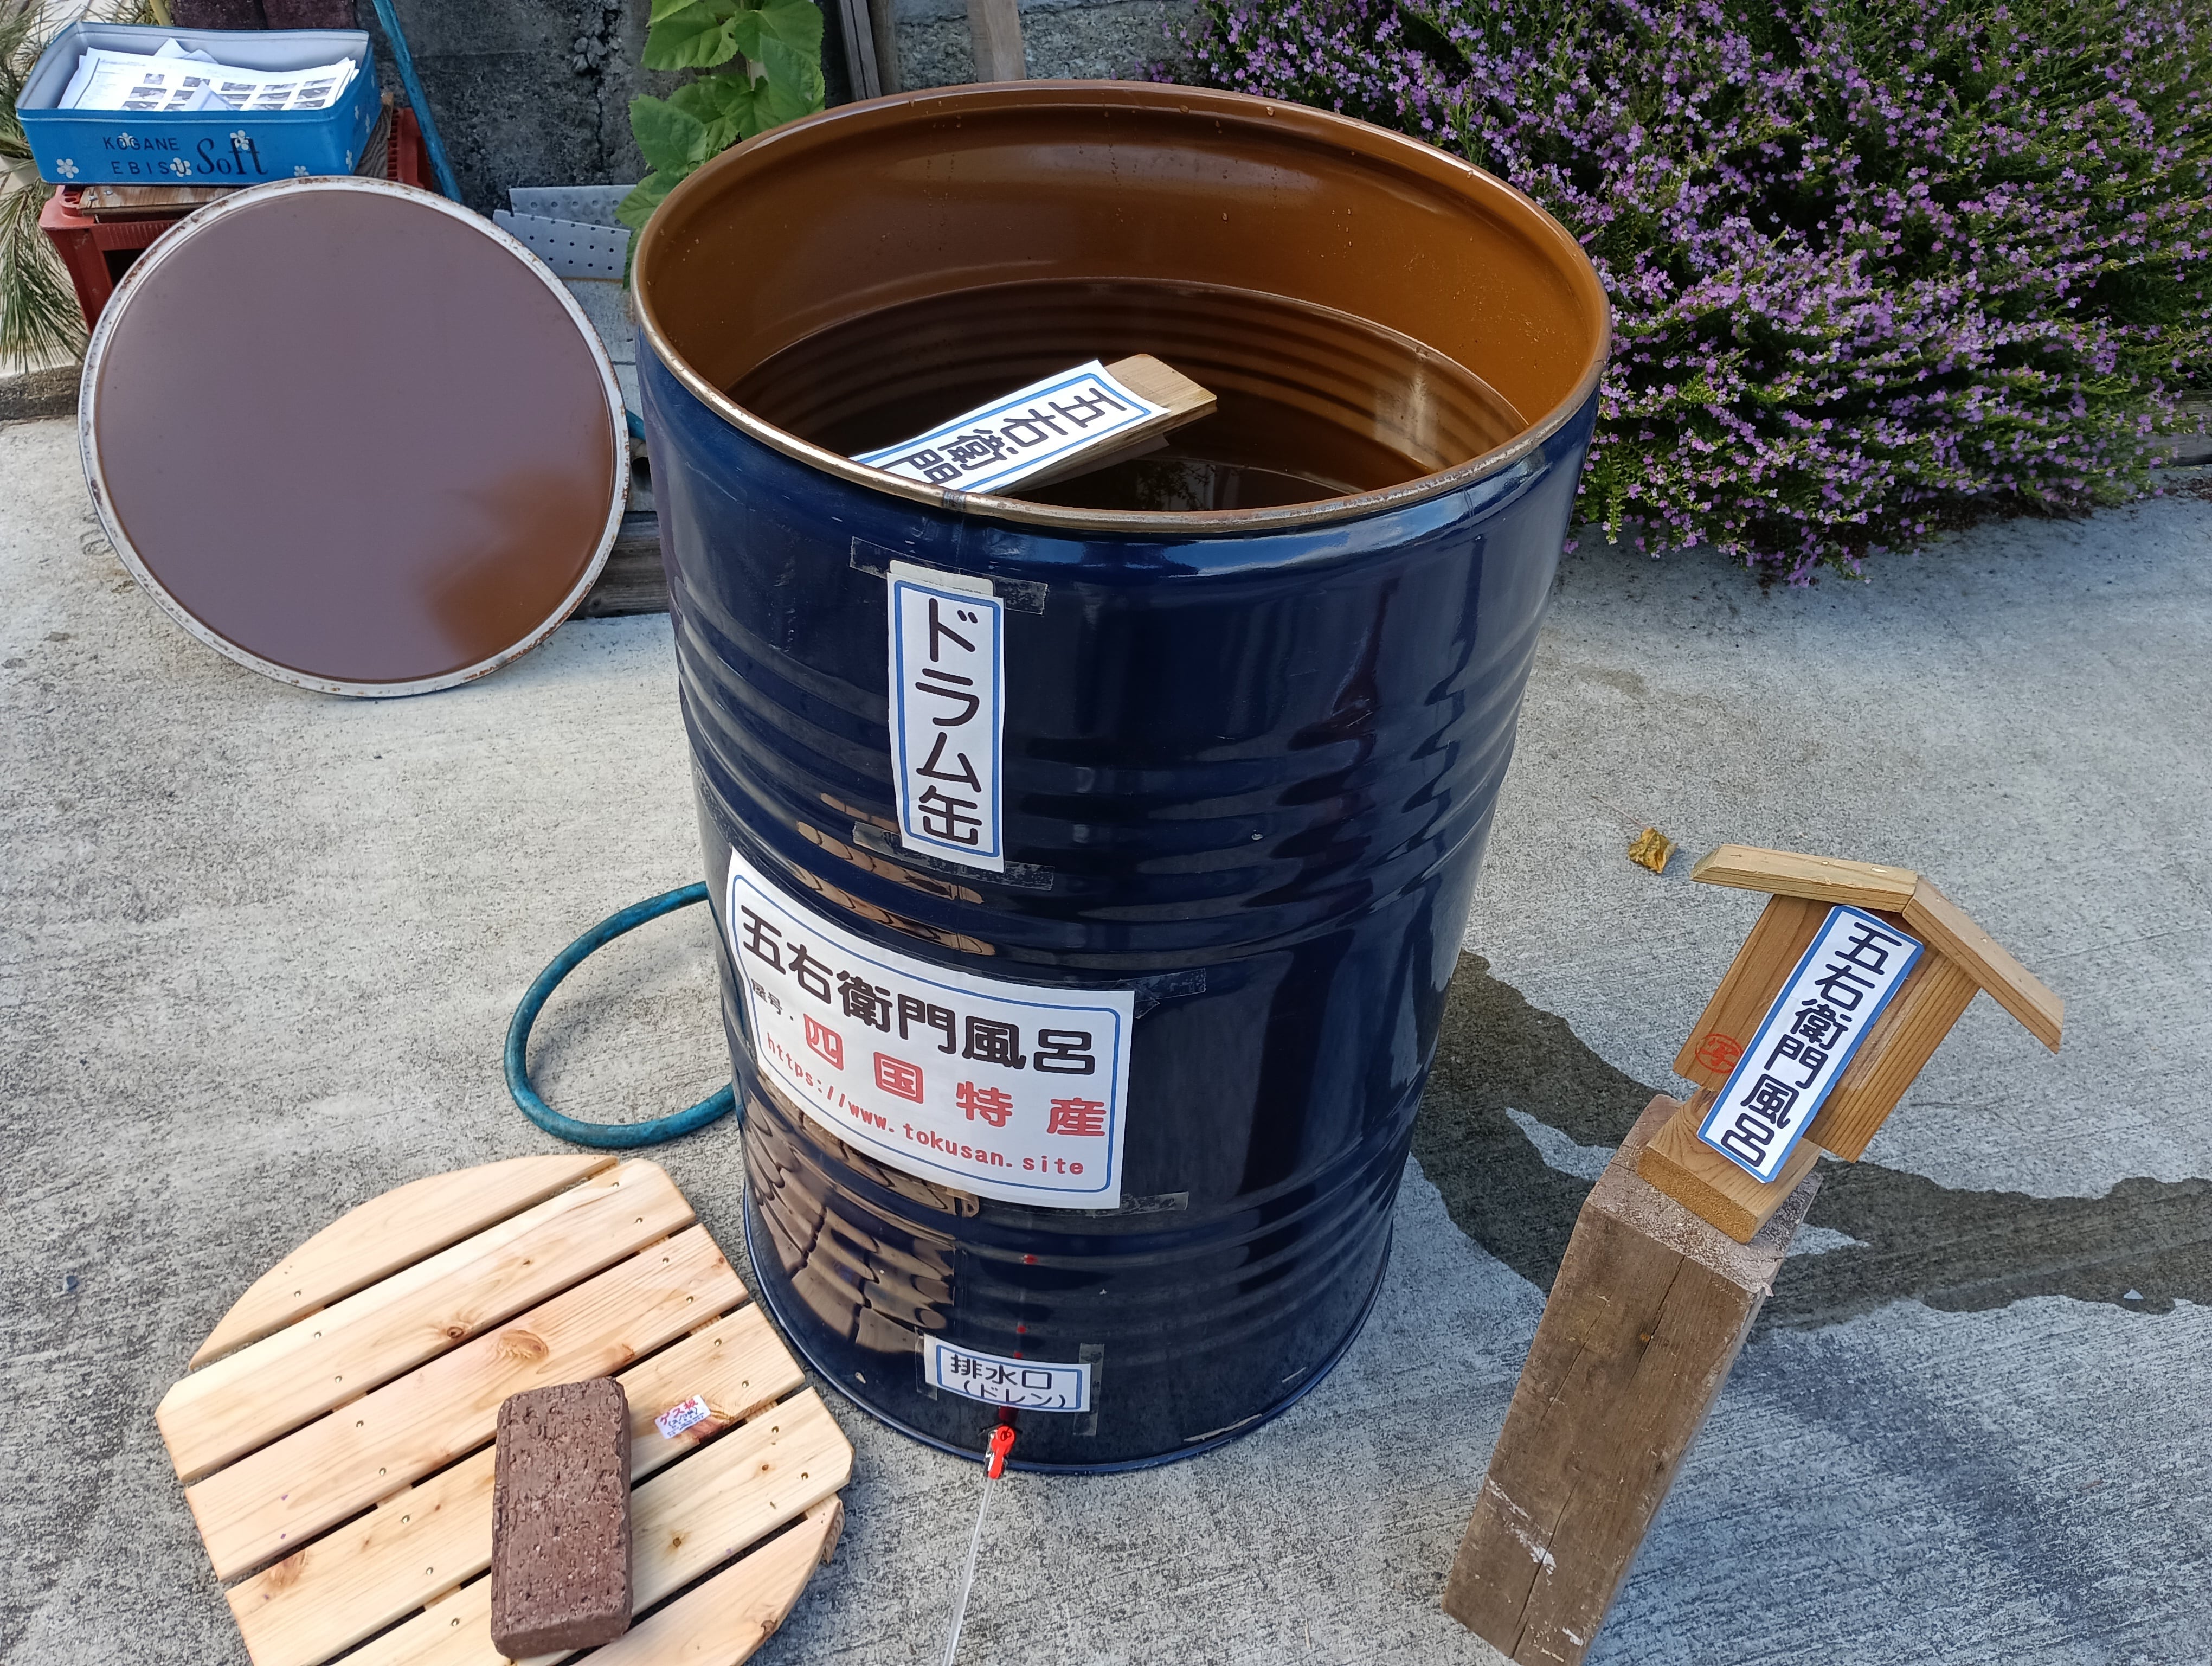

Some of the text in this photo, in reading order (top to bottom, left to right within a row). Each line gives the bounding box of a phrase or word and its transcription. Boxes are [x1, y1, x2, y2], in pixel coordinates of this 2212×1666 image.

[102, 137, 181, 151] KOGANE
[111, 161, 187, 175] EBISU
[196, 137, 269, 175] Soft
[915, 598, 983, 846] ドラム缶
[741, 904, 1096, 1076] 五右衛門風呂
[1720, 921, 1903, 1168] 五右衛門風呂
[767, 1032, 1084, 1175] https://www.tokusan.site
[803, 1013, 1107, 1137] 四国特産
[950, 1354, 1052, 1390] 排水口
